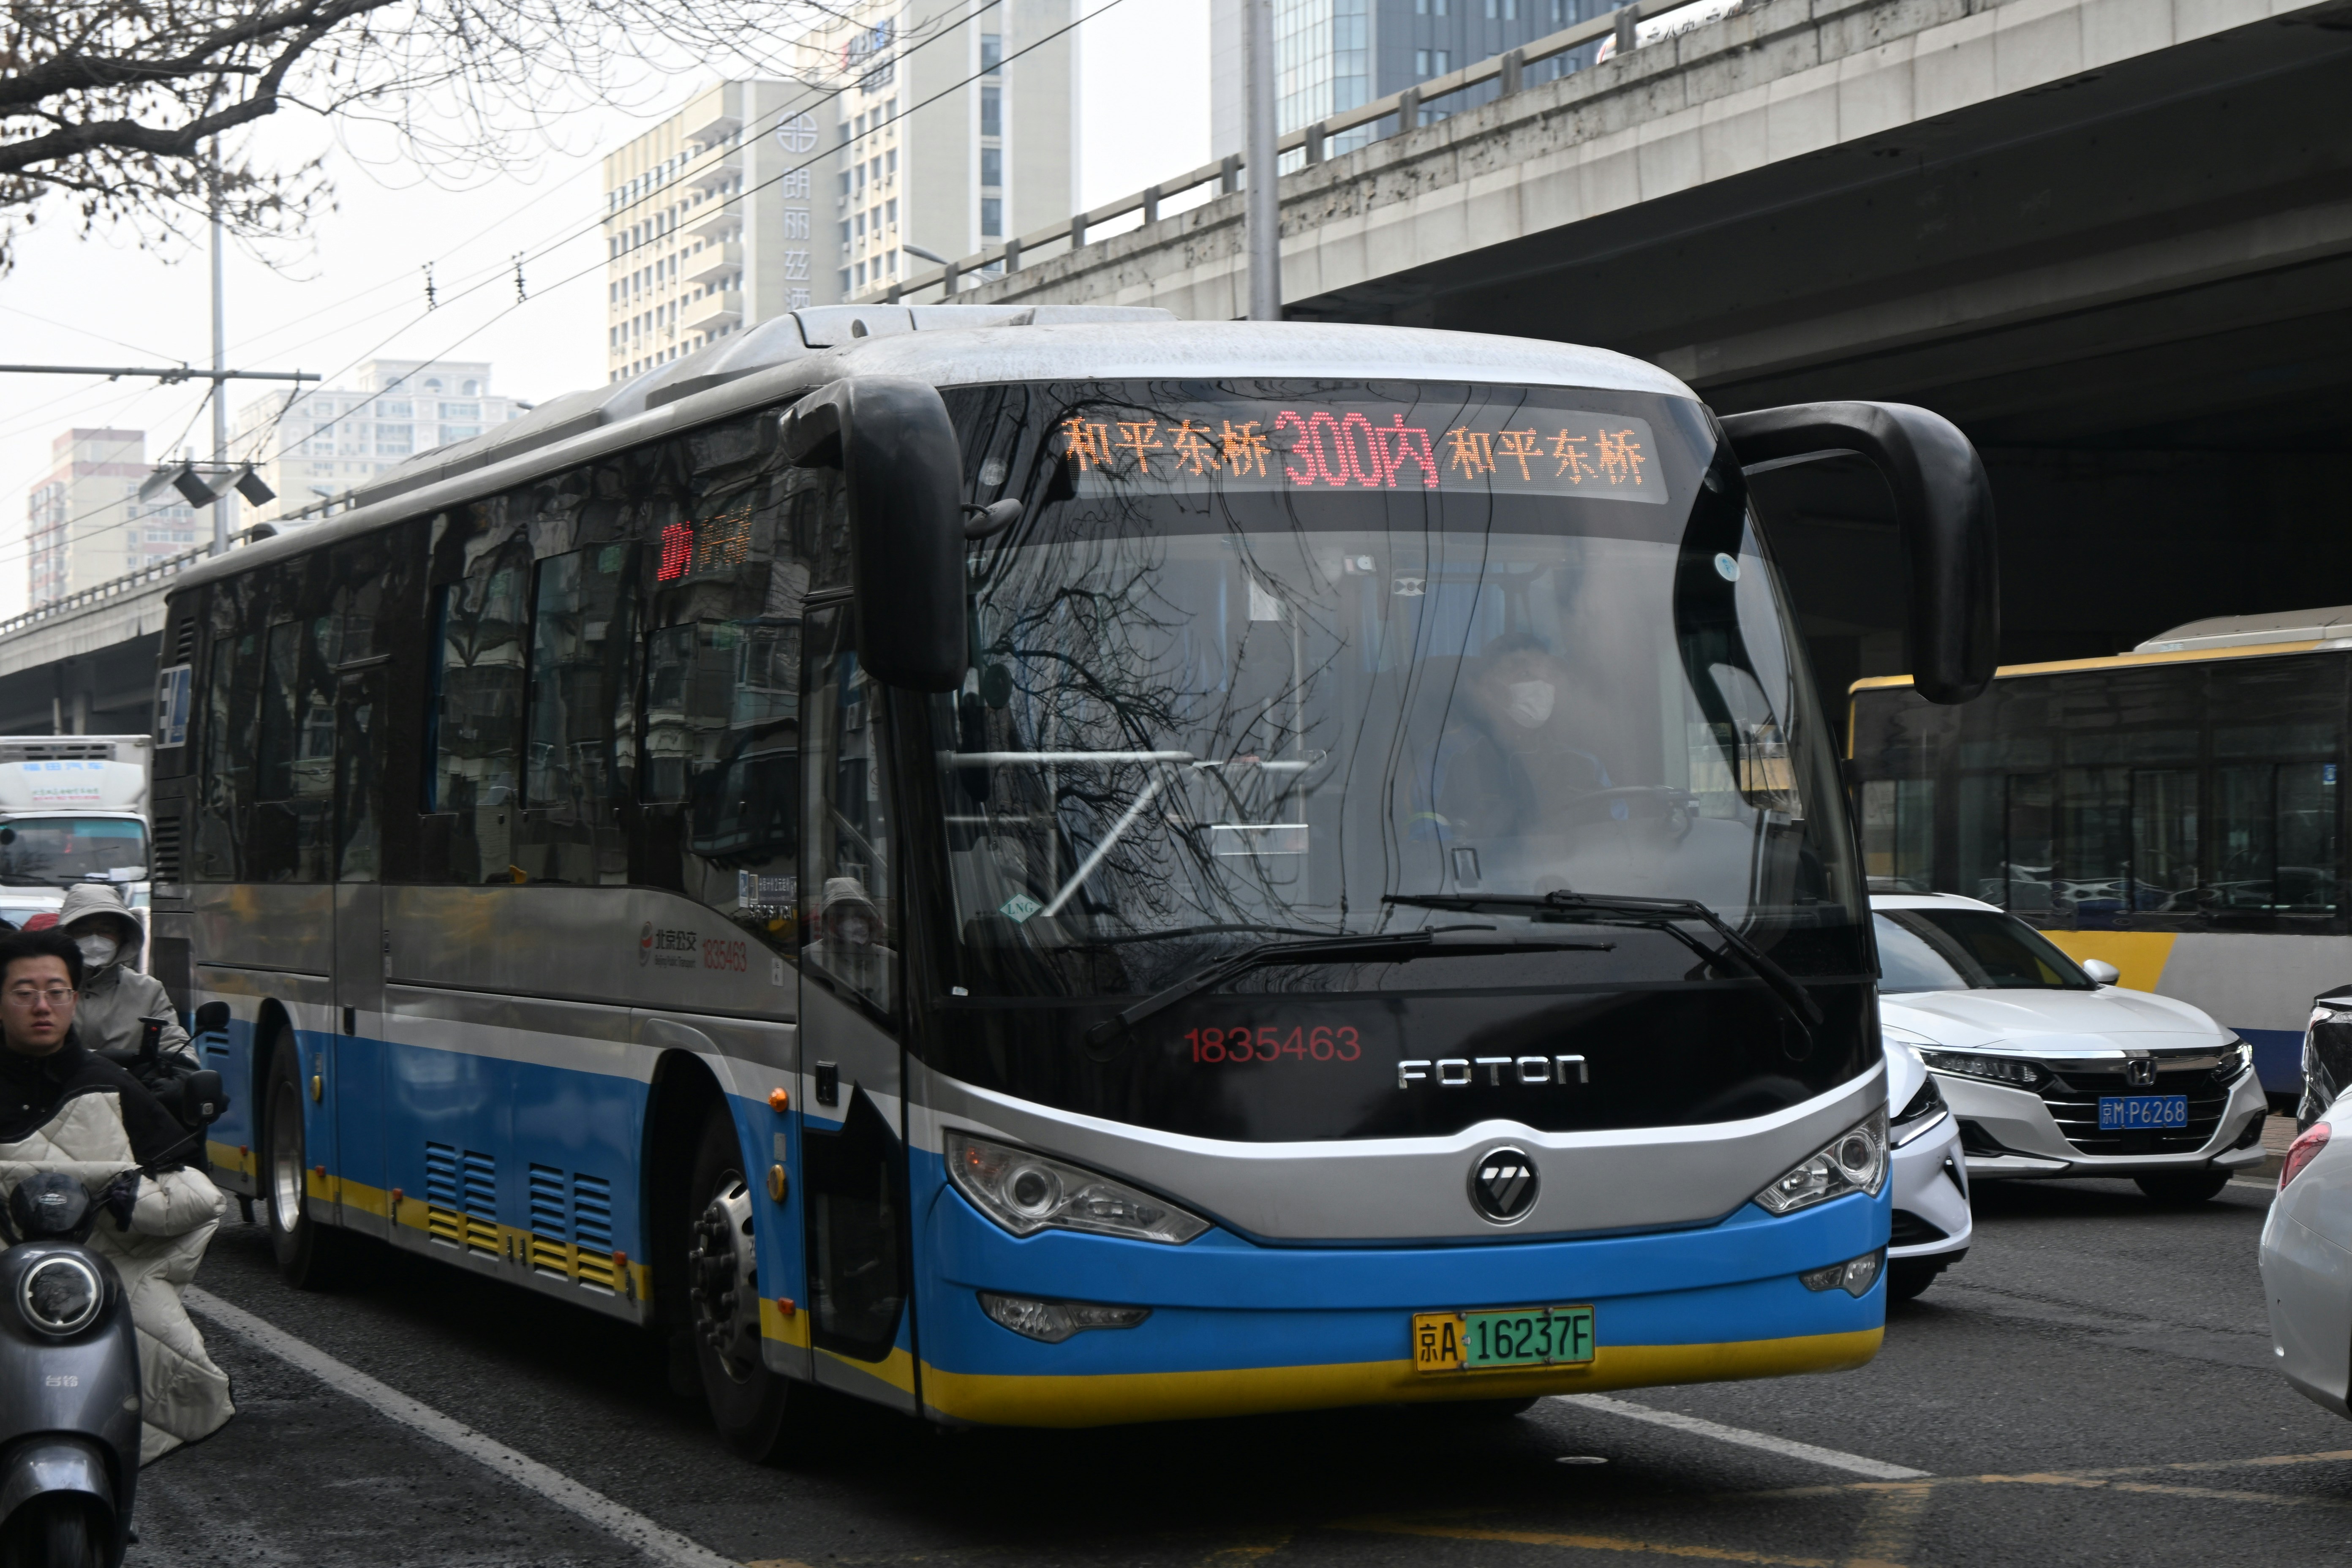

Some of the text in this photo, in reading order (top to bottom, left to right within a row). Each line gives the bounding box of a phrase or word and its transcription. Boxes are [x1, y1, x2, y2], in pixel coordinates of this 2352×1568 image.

[1061, 411, 1646, 488] 和平东桥 300内 和平东桥
[1008, 903, 1033, 914] LNG
[656, 929, 696, 951] 北京公交
[703, 939, 746, 972] 1835463
[1184, 1026, 1361, 1063] 1835463
[1397, 1054, 1588, 1089] FOTON
[46, 1375, 78, 1387] 台铃
